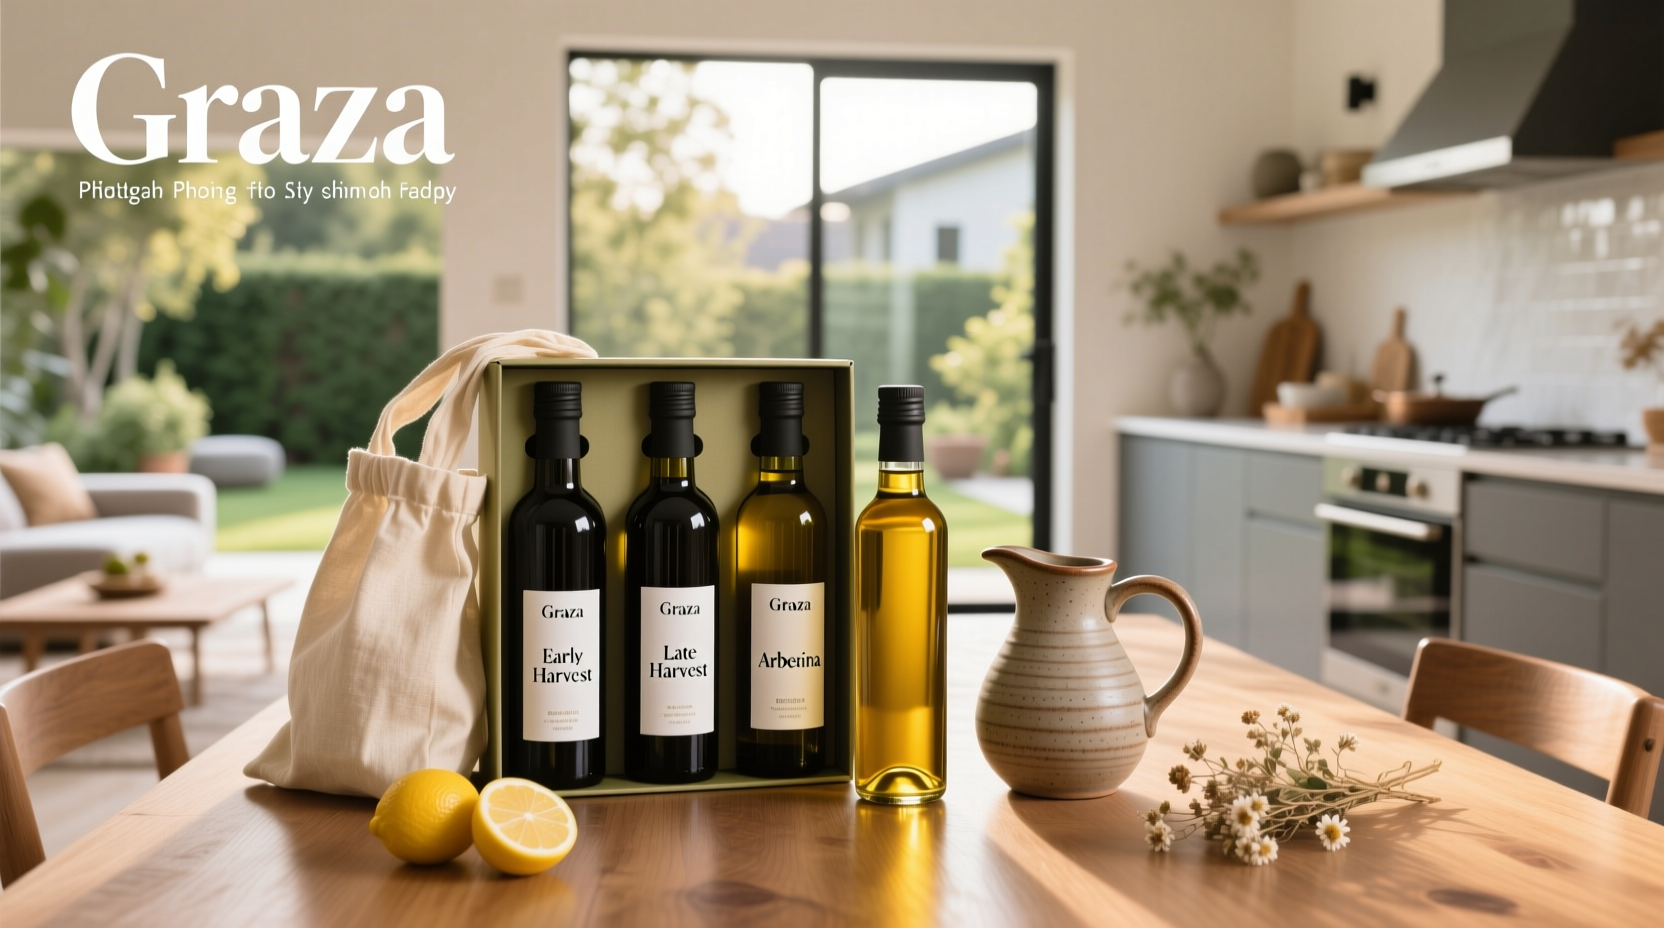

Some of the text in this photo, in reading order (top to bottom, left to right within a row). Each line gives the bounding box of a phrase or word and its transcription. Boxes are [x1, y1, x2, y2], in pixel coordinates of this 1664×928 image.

[541, 604, 584, 619] Graza
[660, 601, 700, 615] Graza
[769, 597, 811, 611] Graza
[543, 646, 583, 666] Early
[664, 645, 697, 660] Late
[532, 667, 592, 683] Harvest
[649, 662, 708, 678] Harvest
